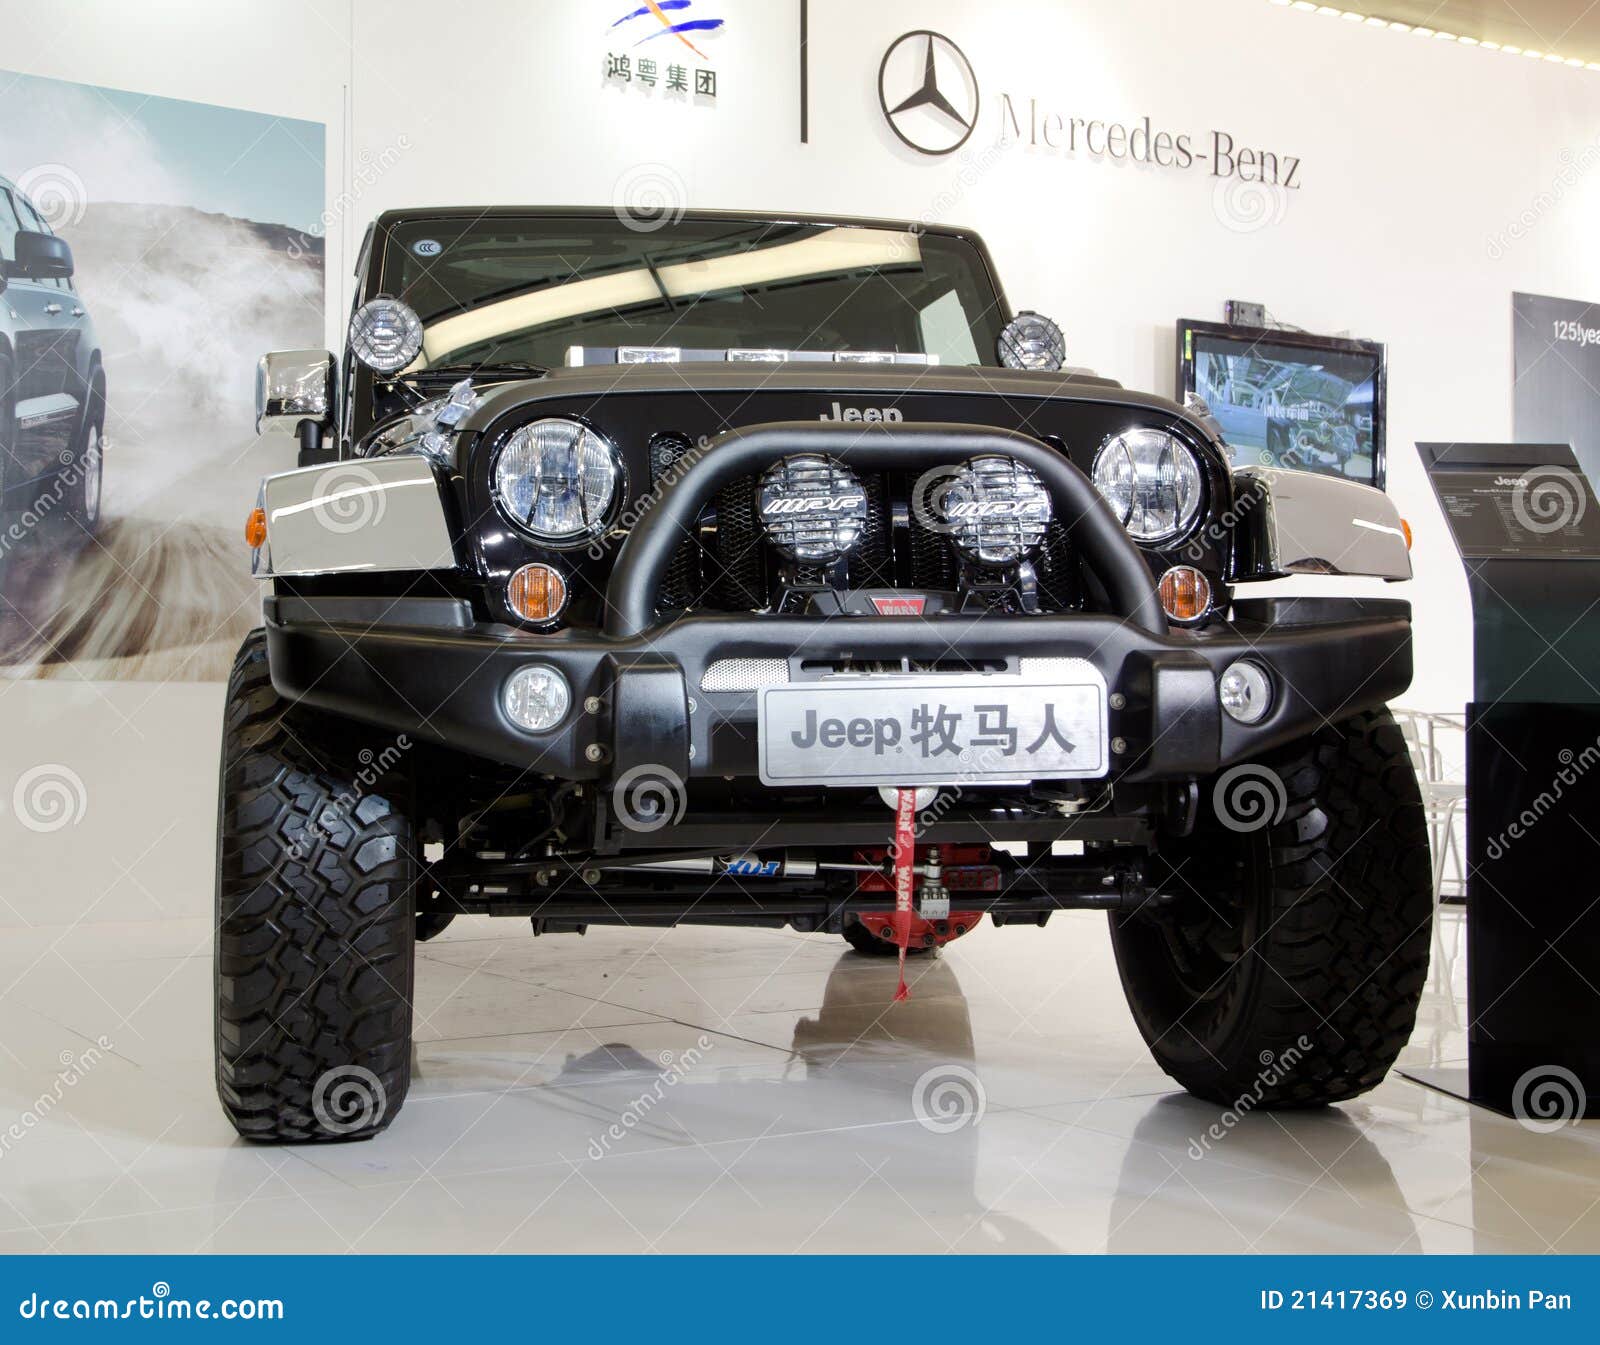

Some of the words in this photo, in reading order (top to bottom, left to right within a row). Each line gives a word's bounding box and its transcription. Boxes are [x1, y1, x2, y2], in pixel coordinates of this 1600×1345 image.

[607, 52, 717, 97] 鸿粤集团
[1001, 93, 1301, 189] Mercedes-Benz
[820, 402, 903, 422] Jeep
[1494, 476, 1528, 487] Jeep
[790, 709, 901, 755] Jeep
[910, 703, 1077, 757] 牧马人
[899, 788, 914, 832] WARN
[897, 866, 911, 912] WARN
